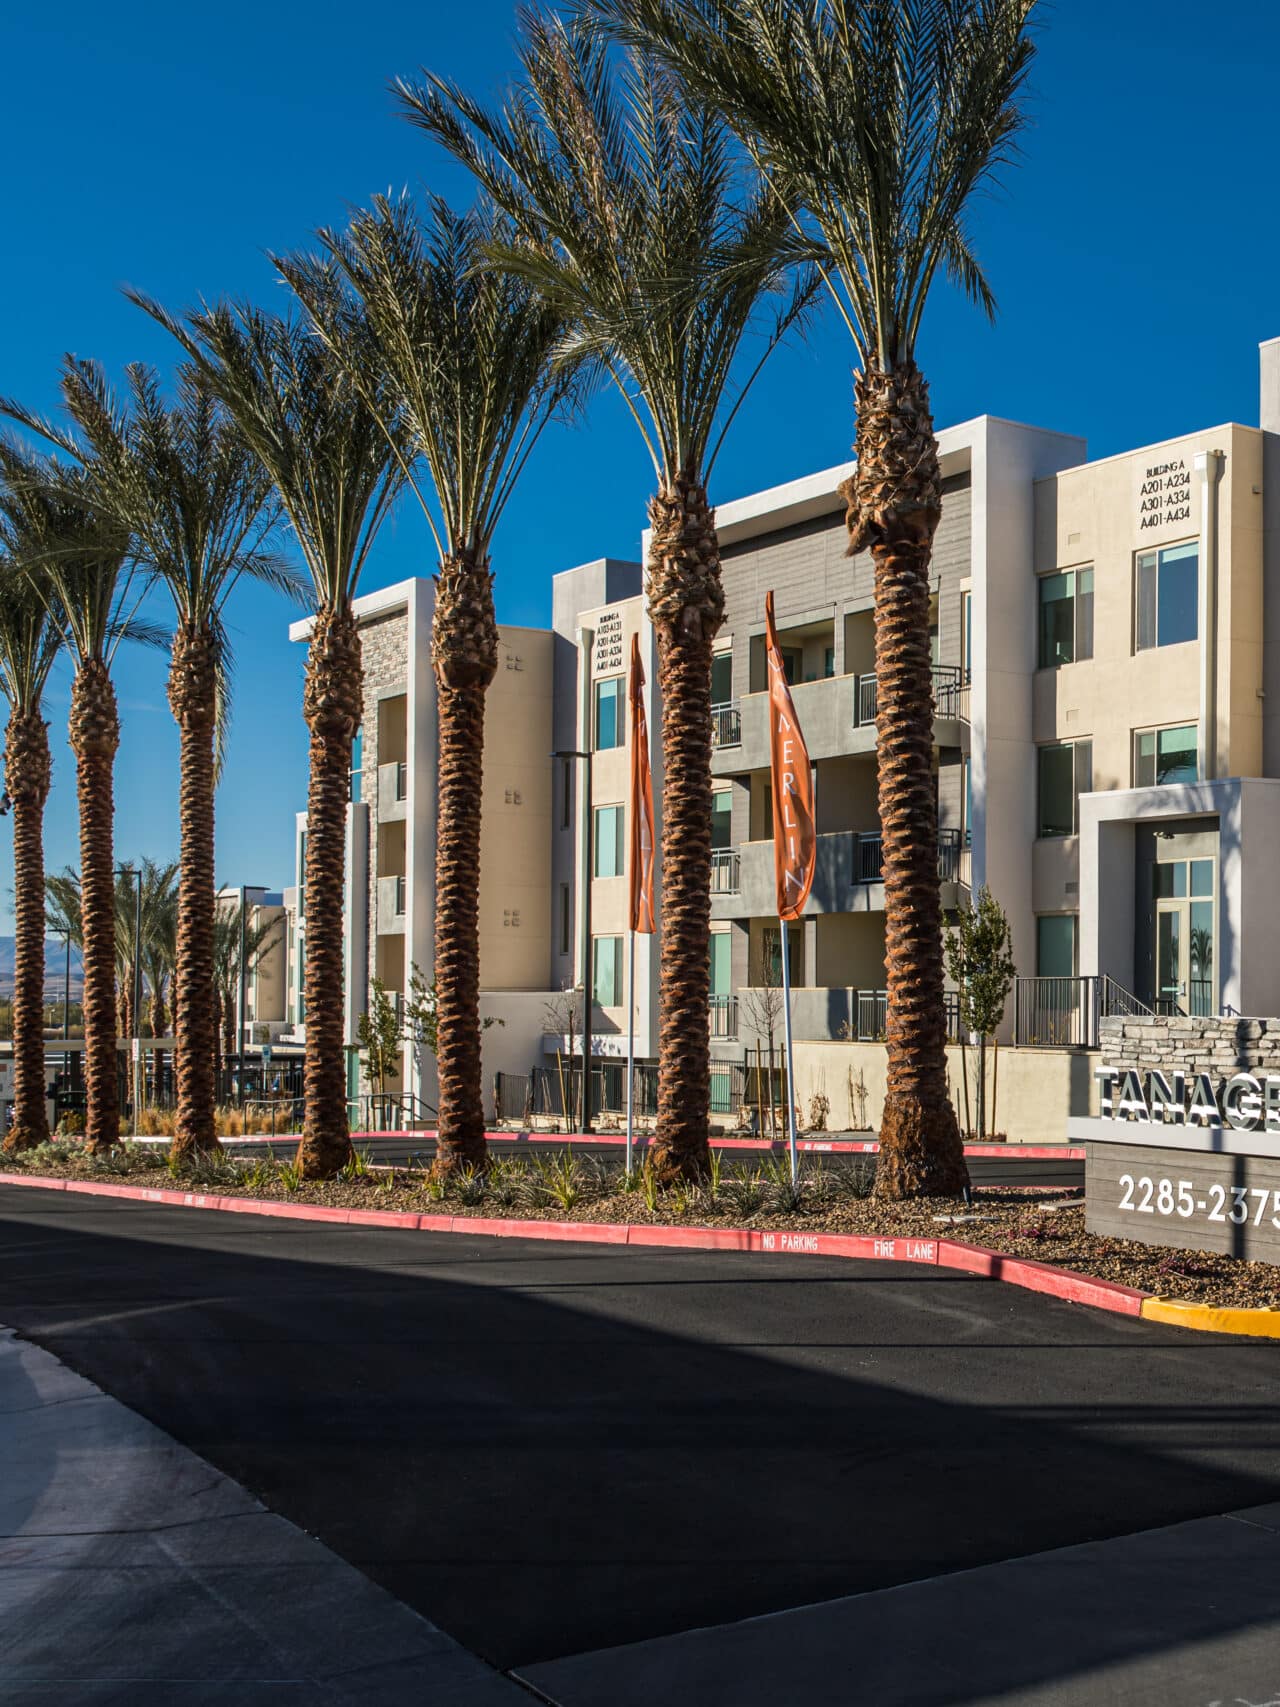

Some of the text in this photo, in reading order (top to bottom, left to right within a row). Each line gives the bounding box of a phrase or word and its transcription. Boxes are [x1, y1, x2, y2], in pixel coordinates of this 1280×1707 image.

[1146, 460, 1185, 478] BUILDING A
[1140, 472, 1190, 496] A201-A234
[1140, 488, 1190, 513] A301-A334
[1140, 505, 1190, 530] A401-A434
[763, 1235, 934, 1259] NO PARKING FIRE LANE
